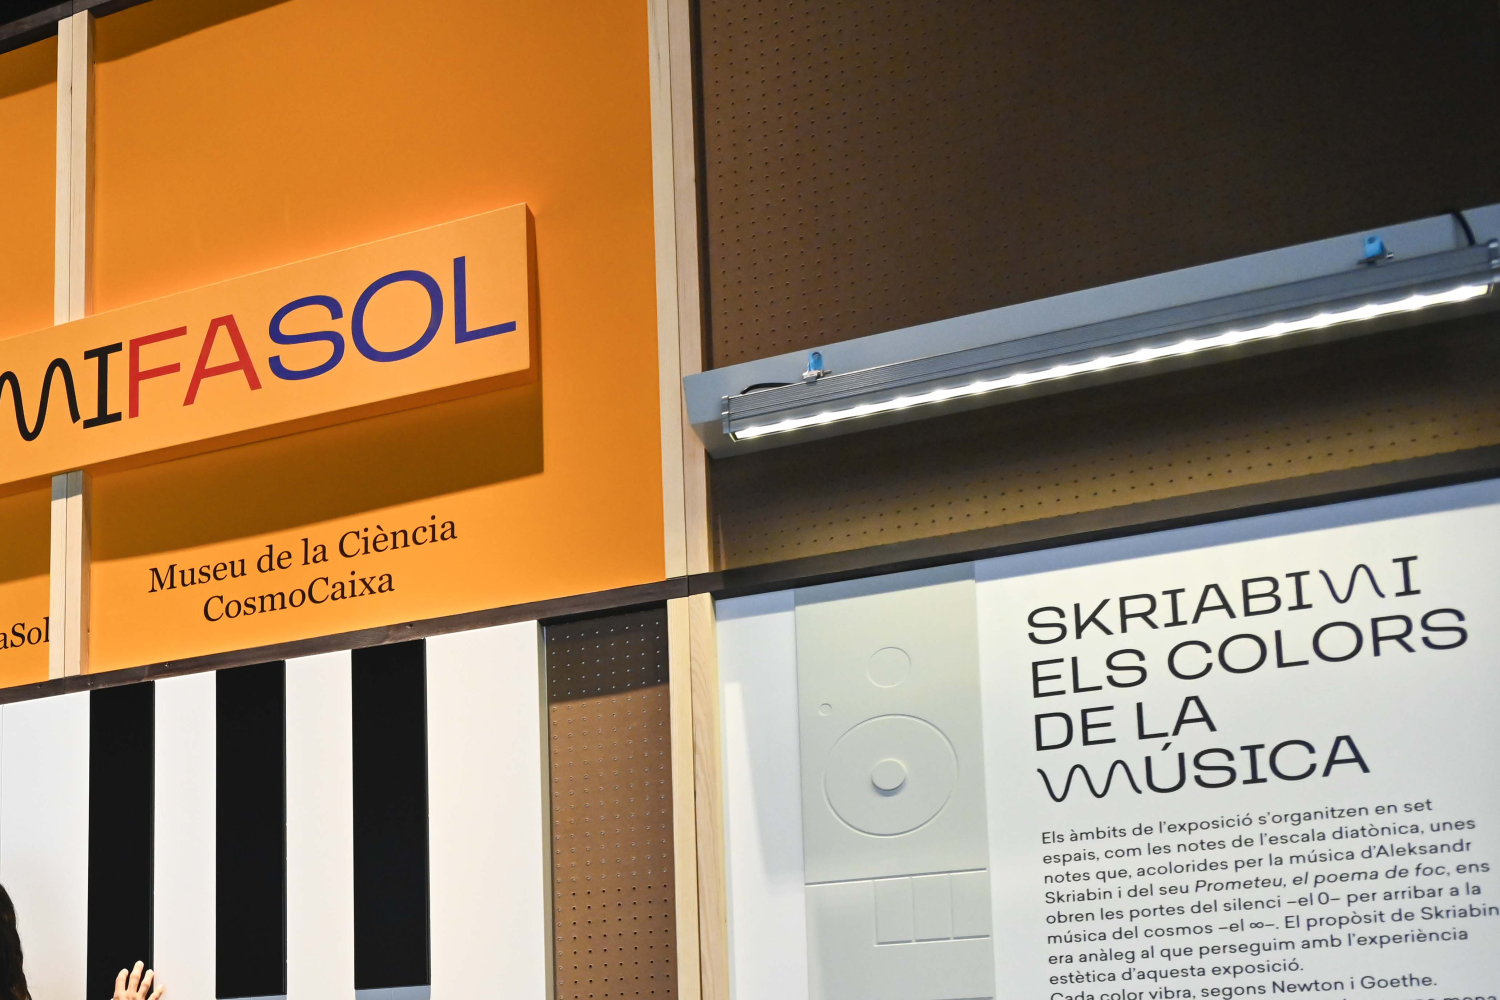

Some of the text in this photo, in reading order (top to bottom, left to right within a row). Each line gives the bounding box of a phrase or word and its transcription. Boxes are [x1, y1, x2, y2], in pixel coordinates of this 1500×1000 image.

[148, 516, 458, 593] Museu de la Ciència
[203, 573, 395, 622] CosmoCaixa
[1031, 608, 1468, 699] ELS COLORS
[1034, 695, 1218, 752] DE LA
[1036, 735, 1371, 803] MÚSICA
[1041, 830, 1065, 845] Els
[1069, 826, 1127, 843] àmbits
[1131, 822, 1154, 837] de
[1374, 804, 1398, 815] en
[1403, 798, 1433, 813] set
[1042, 848, 1100, 867] espais,
[1104, 847, 1142, 859] com
[1147, 842, 1172, 856] les
[1176, 839, 1227, 853] notes
[1231, 834, 1255, 849] de
[1331, 822, 1425, 840] diatònica,
[1429, 819, 1476, 833] unes
[1044, 870, 1091, 885] notes
[1095, 868, 1133, 884] que,
[1136, 858, 1229, 877] acolorides
[1233, 857, 1264, 873] per
[1268, 852, 1284, 867] la
[1289, 848, 1355, 865] música
[1045, 862, 1491, 905] Skriabin i del seu Prometeu, el poema de foc, ens
[1045, 910, 1095, 925] obren
[1100, 907, 1125, 921] les
[1129, 904, 1186, 923] portes
[1190, 899, 1218, 914] del
[1222, 894, 1281, 912] silenci
[1346, 892, 1378, 908] per
[1382, 884, 1444, 901] arribar
[1449, 886, 1460, 897] a
[1465, 881, 1482, 896] la
[1047, 929, 1107, 945] música
[1111, 925, 1139, 941] del
[1143, 924, 1214, 938] cosmos
[1284, 914, 1301, 929] El
[1306, 909, 1386, 932] propòsit
[1390, 907, 1416, 923] de
[1420, 903, 1499, 921] Skriabin
[1048, 954, 1074, 965] era
[1078, 947, 1136, 964] anàleg
[1140, 945, 1155, 960] al
[1159, 946, 1194, 962] que
[1198, 937, 1296, 960] perseguim
[1300, 933, 1343, 950] amb
[1049, 969, 1117, 986] estètica
[1210, 957, 1304, 979] exposició.
[1148, 985, 1196, 1000] vibra,
[1200, 984, 1267, 1000] segons
[1271, 979, 1345, 994] Newton
[1349, 976, 1355, 990] i
[1360, 973, 1438, 990] Goethe.
